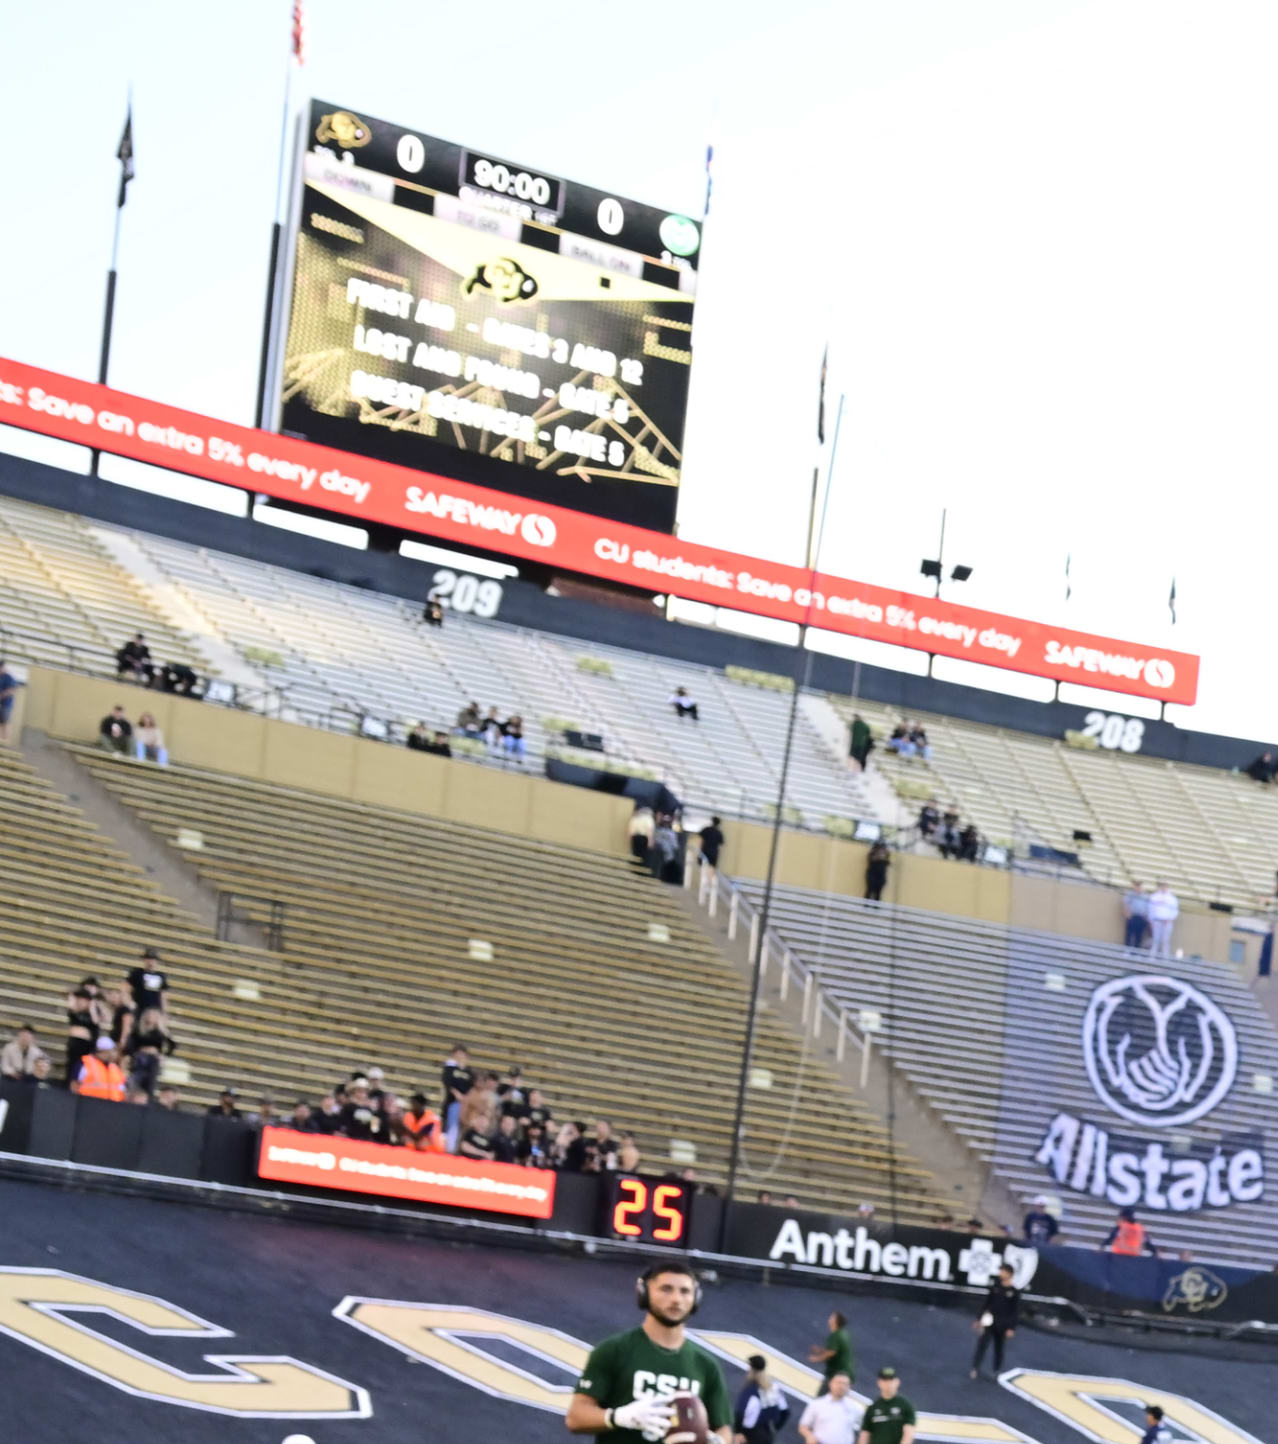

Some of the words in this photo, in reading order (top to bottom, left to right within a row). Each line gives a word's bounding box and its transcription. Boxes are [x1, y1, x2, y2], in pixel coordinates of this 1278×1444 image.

[397, 134, 425, 173] 0
[474, 160, 550, 205] 90:00
[597, 198, 625, 235] 0
[27, 386, 95, 425] Save
[97, 410, 134, 437] an
[137, 421, 204, 456] extra
[208, 436, 245, 467] 5%
[247, 452, 318, 491] every
[319, 468, 372, 504] day
[405, 485, 522, 536] SAFEWAY
[427, 569, 503, 618] 209
[594, 537, 630, 564] CU
[632, 548, 734, 590] students:
[736, 571, 793, 602] Save
[794, 587, 825, 610] an
[827, 595, 883, 623] extra
[918, 616, 978, 648] every
[978, 627, 1022, 658] day
[1044, 640, 1146, 680] SAFEWAY
[1082, 711, 1145, 753] 208
[1035, 1112, 1264, 1211] Allstate
[613, 1178, 684, 1241] 25
[769, 1218, 951, 1281] Anthem
[633, 1370, 701, 1400] CSU
